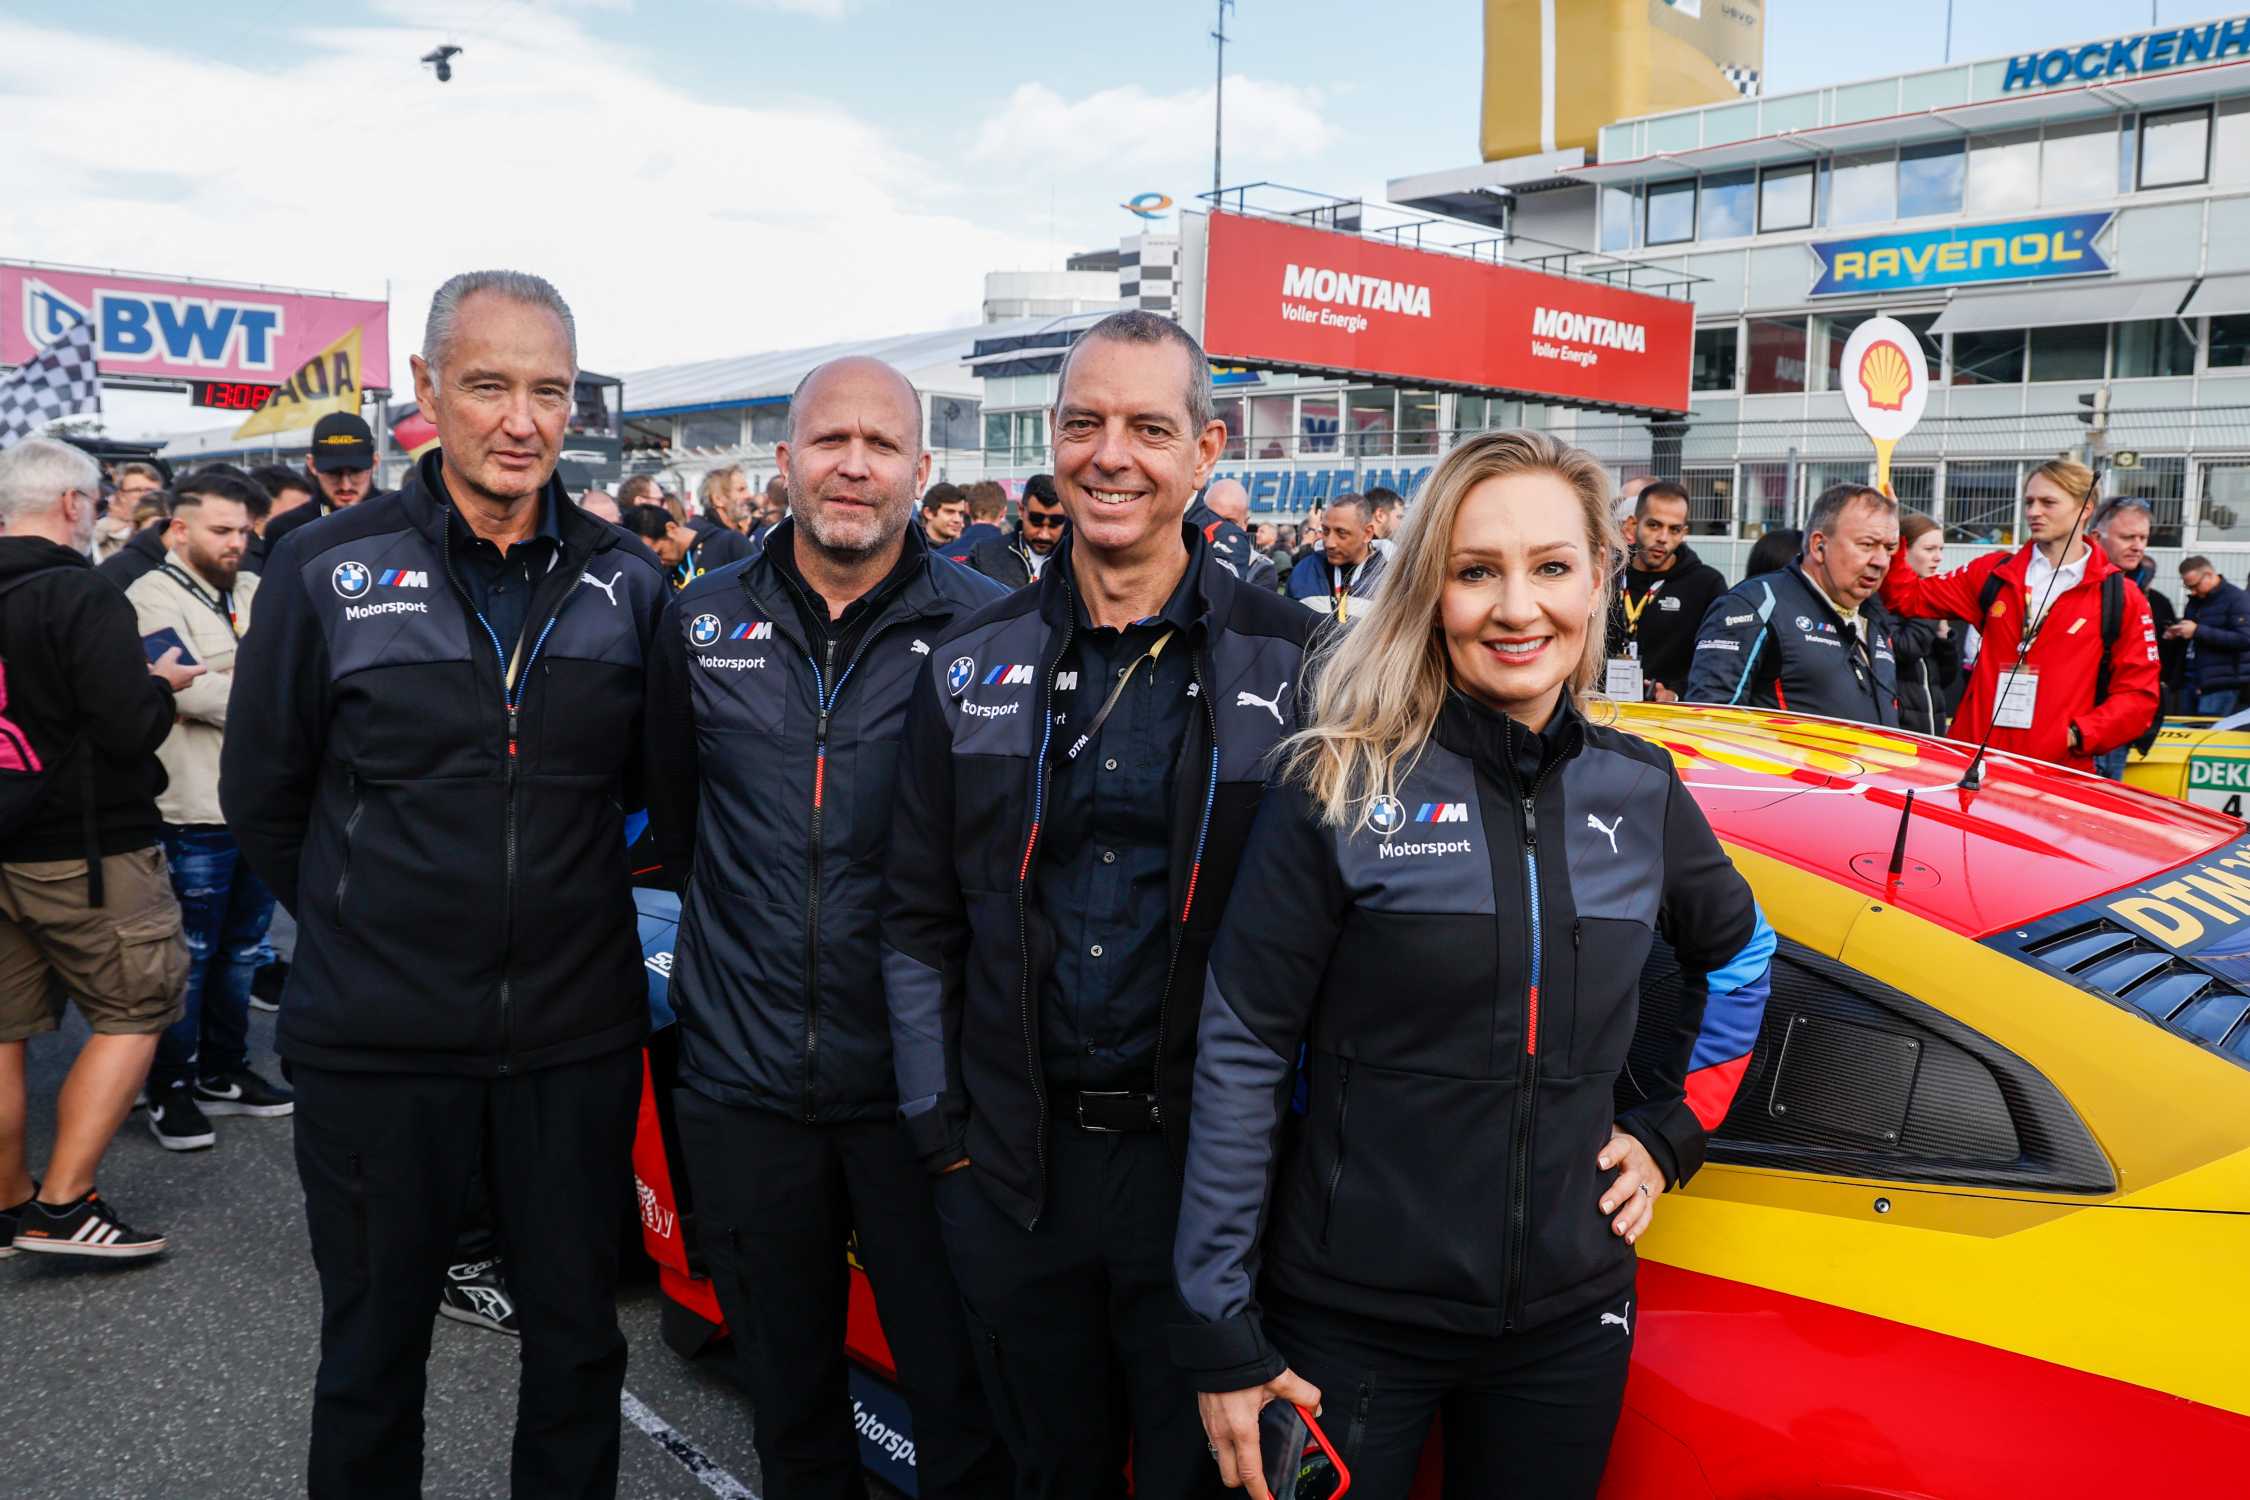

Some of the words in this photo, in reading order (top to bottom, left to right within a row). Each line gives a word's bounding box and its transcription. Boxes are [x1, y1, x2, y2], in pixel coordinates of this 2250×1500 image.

[1834, 231, 2083, 281] RAVENOL
[1282, 264, 1431, 318] MONTANA
[100, 294, 278, 365] BWT
[1282, 302, 1319, 324] Voller
[1320, 308, 1368, 333] Energie
[1532, 307, 1646, 353] MONTANA
[1532, 341, 1561, 359] Voller
[1560, 346, 1598, 368] Energie
[345, 601, 428, 621] Motorsport
[697, 655, 766, 671] Motorsport
[961, 699, 1019, 719] torsport
[1068, 734, 1089, 759] DTM
[1379, 840, 1472, 860] Motorsport
[2107, 866, 2250, 948] DTM
[850, 1398, 917, 1467] otorsp
